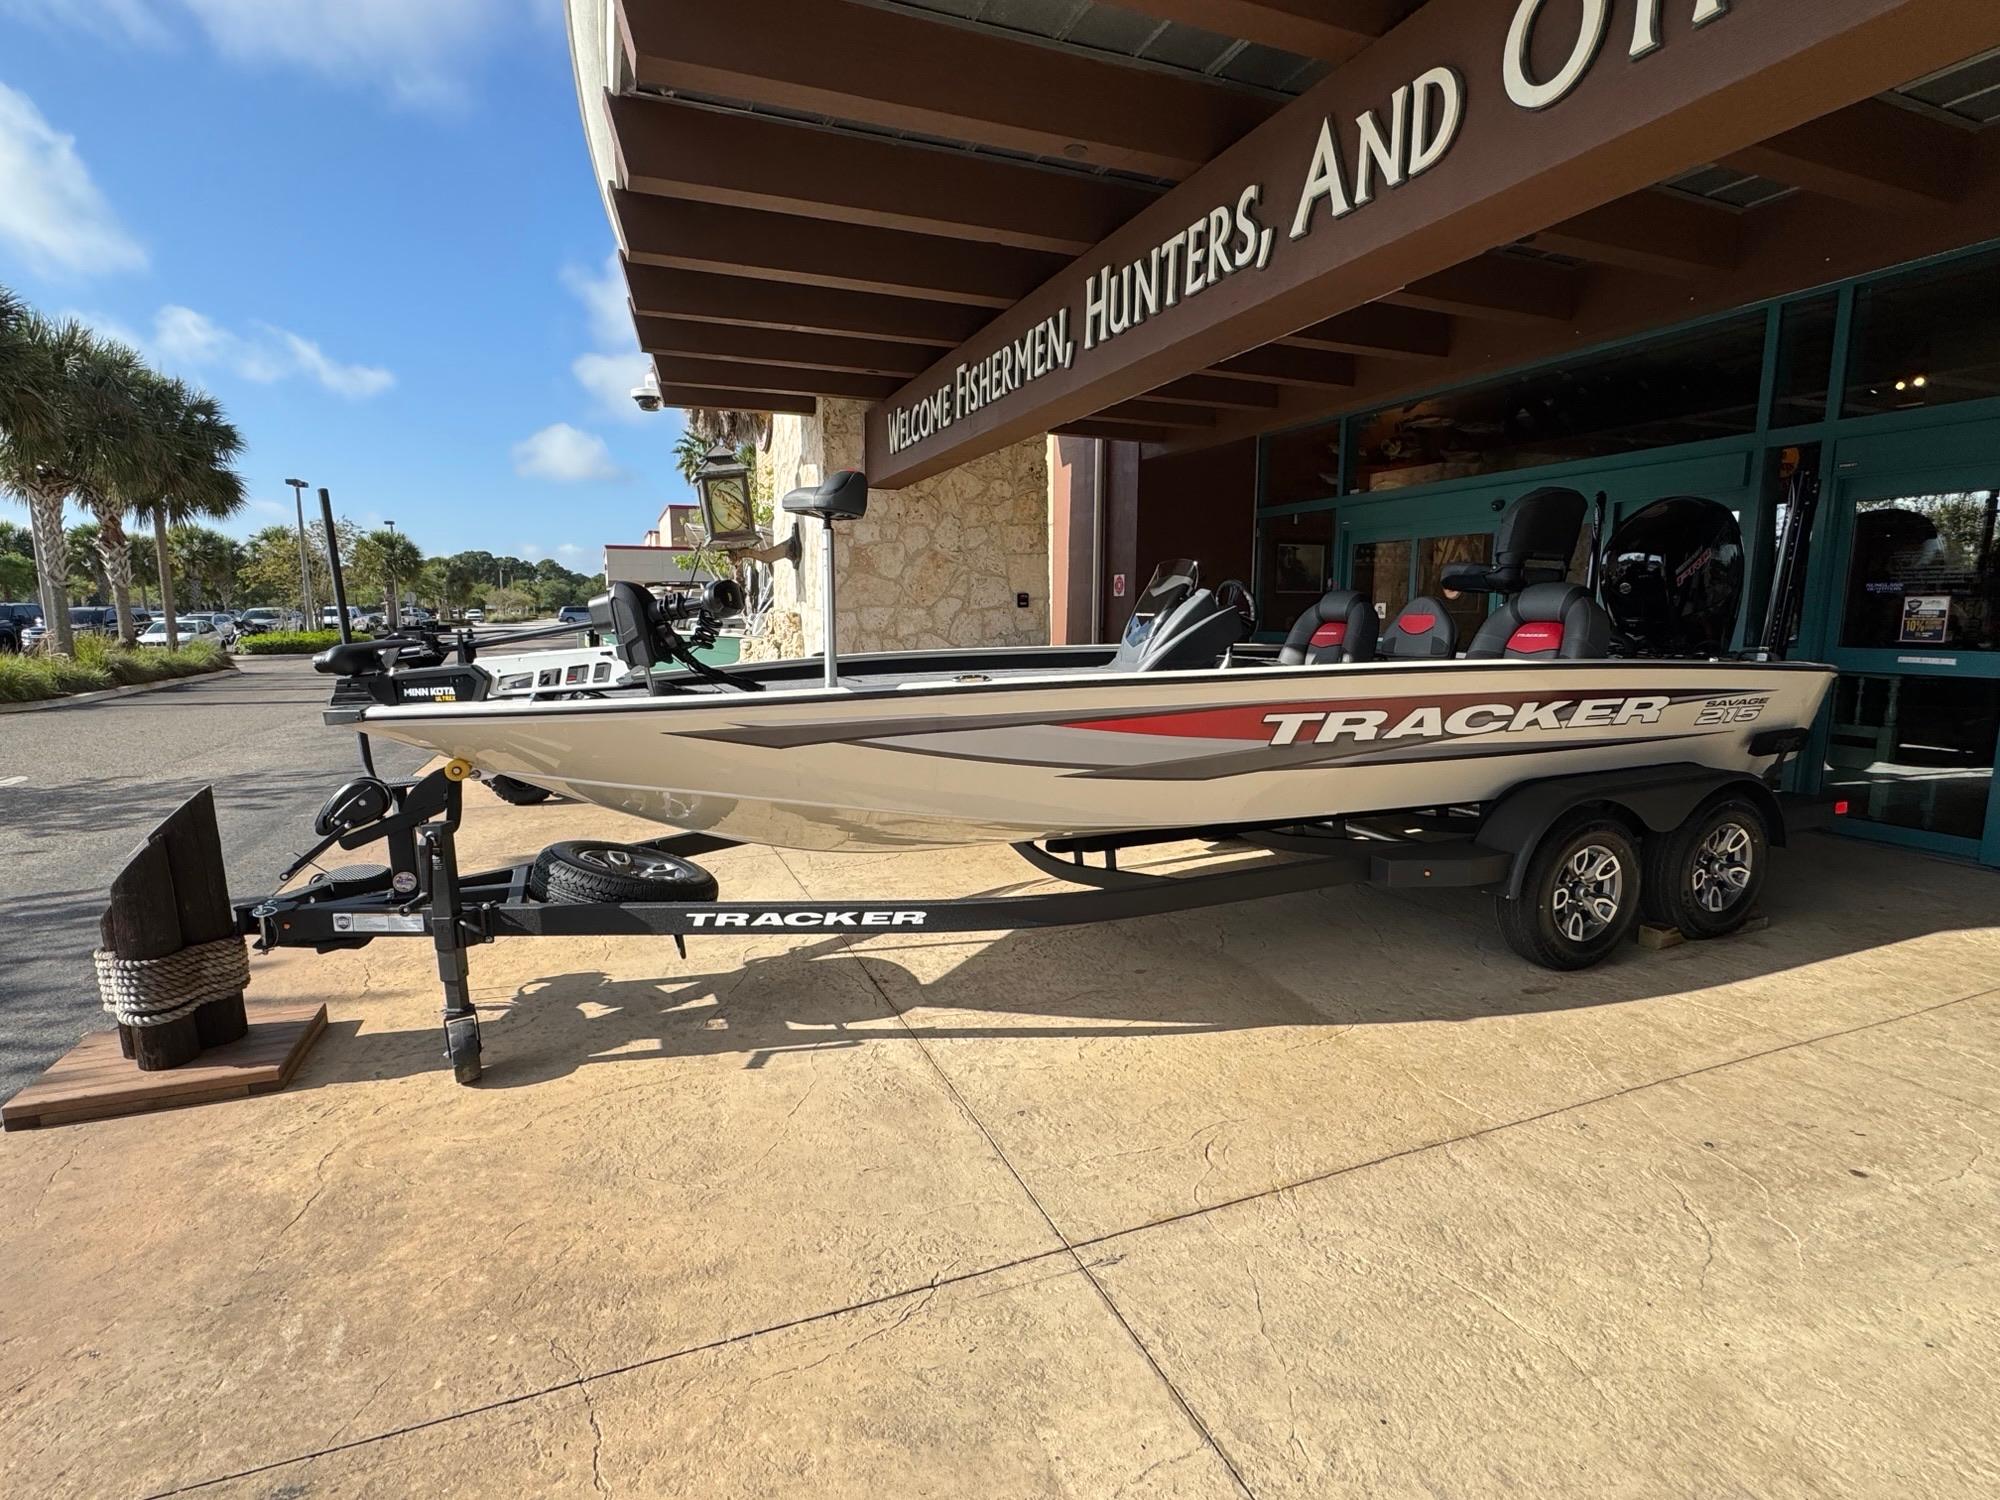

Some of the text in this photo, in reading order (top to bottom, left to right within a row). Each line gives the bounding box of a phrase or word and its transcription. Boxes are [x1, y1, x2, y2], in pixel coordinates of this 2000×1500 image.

[403, 686, 456, 697] MINN KOTA
[1705, 697, 1771, 708] SAVAGE
[1262, 695, 1671, 746] TRACKER
[1693, 705, 1765, 725] 215
[686, 911, 928, 927] TRACKER
